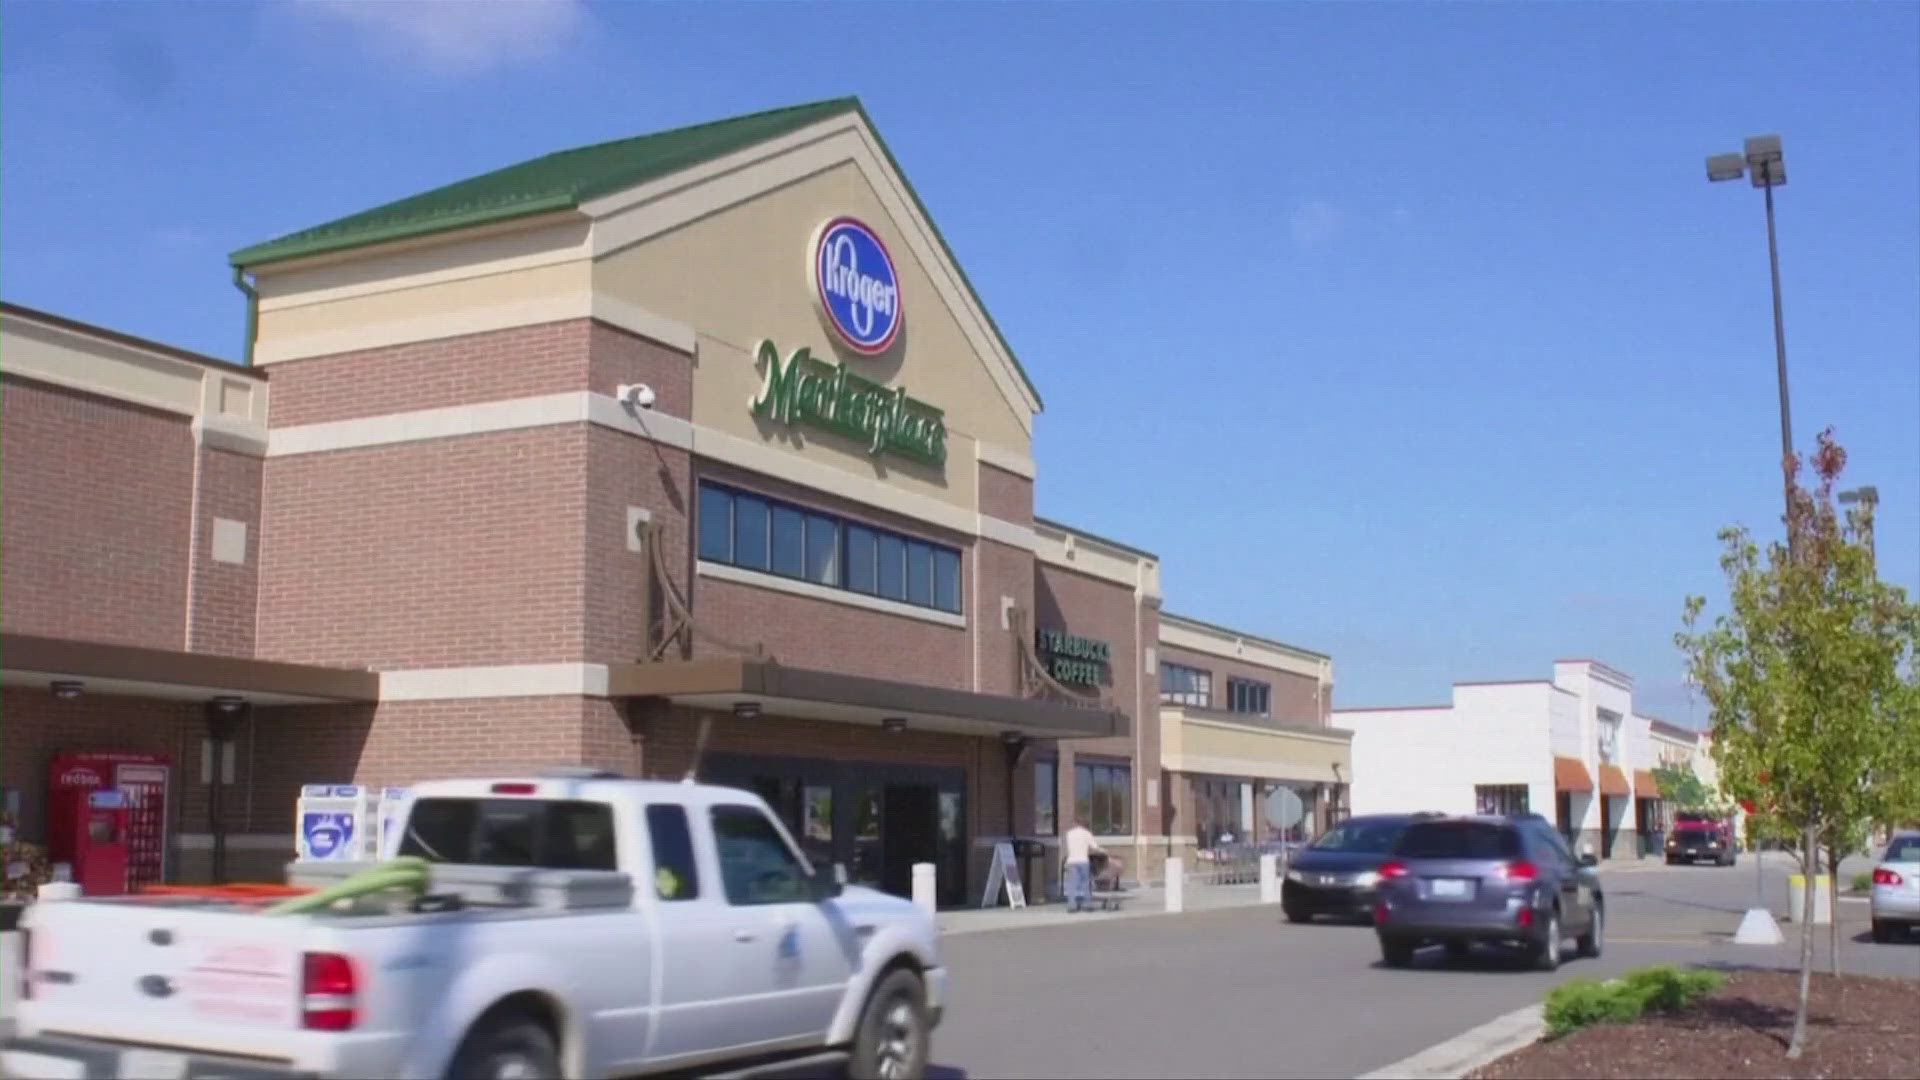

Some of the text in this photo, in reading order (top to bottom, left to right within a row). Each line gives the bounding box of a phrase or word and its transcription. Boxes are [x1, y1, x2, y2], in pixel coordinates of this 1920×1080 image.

[825, 234, 896, 337] Kroger
[748, 339, 947, 467] Marketplace
[1055, 658, 1104, 687] COFFEE
